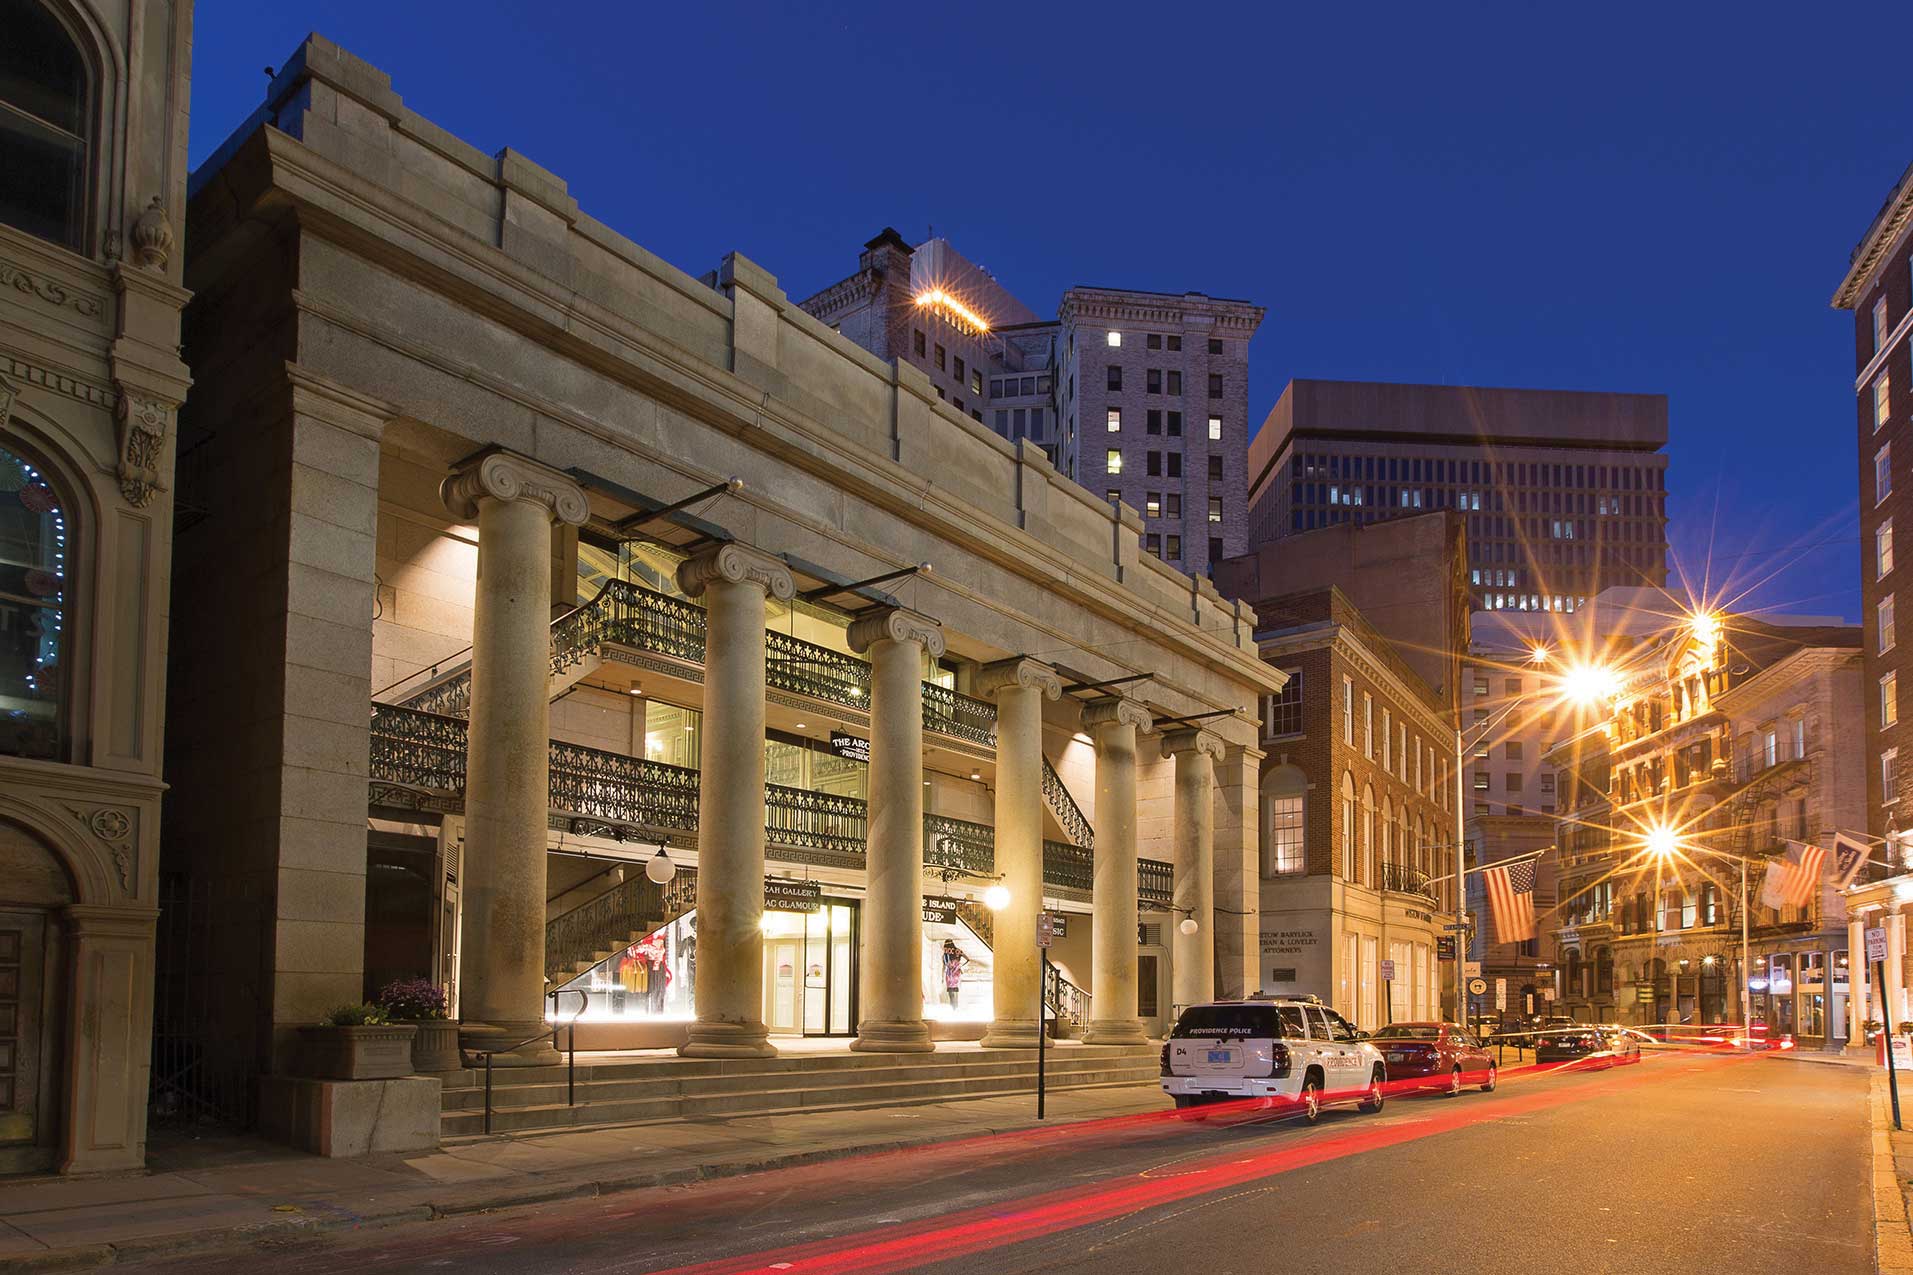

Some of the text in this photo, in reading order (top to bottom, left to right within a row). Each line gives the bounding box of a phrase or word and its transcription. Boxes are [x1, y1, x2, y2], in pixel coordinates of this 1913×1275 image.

[832, 738, 850, 747] THE
[782, 887, 817, 897] GALLERY
[929, 900, 956, 910] ISLAND
[1229, 1027, 1253, 1035] POLICE
[1176, 1048, 1188, 1056] D4
